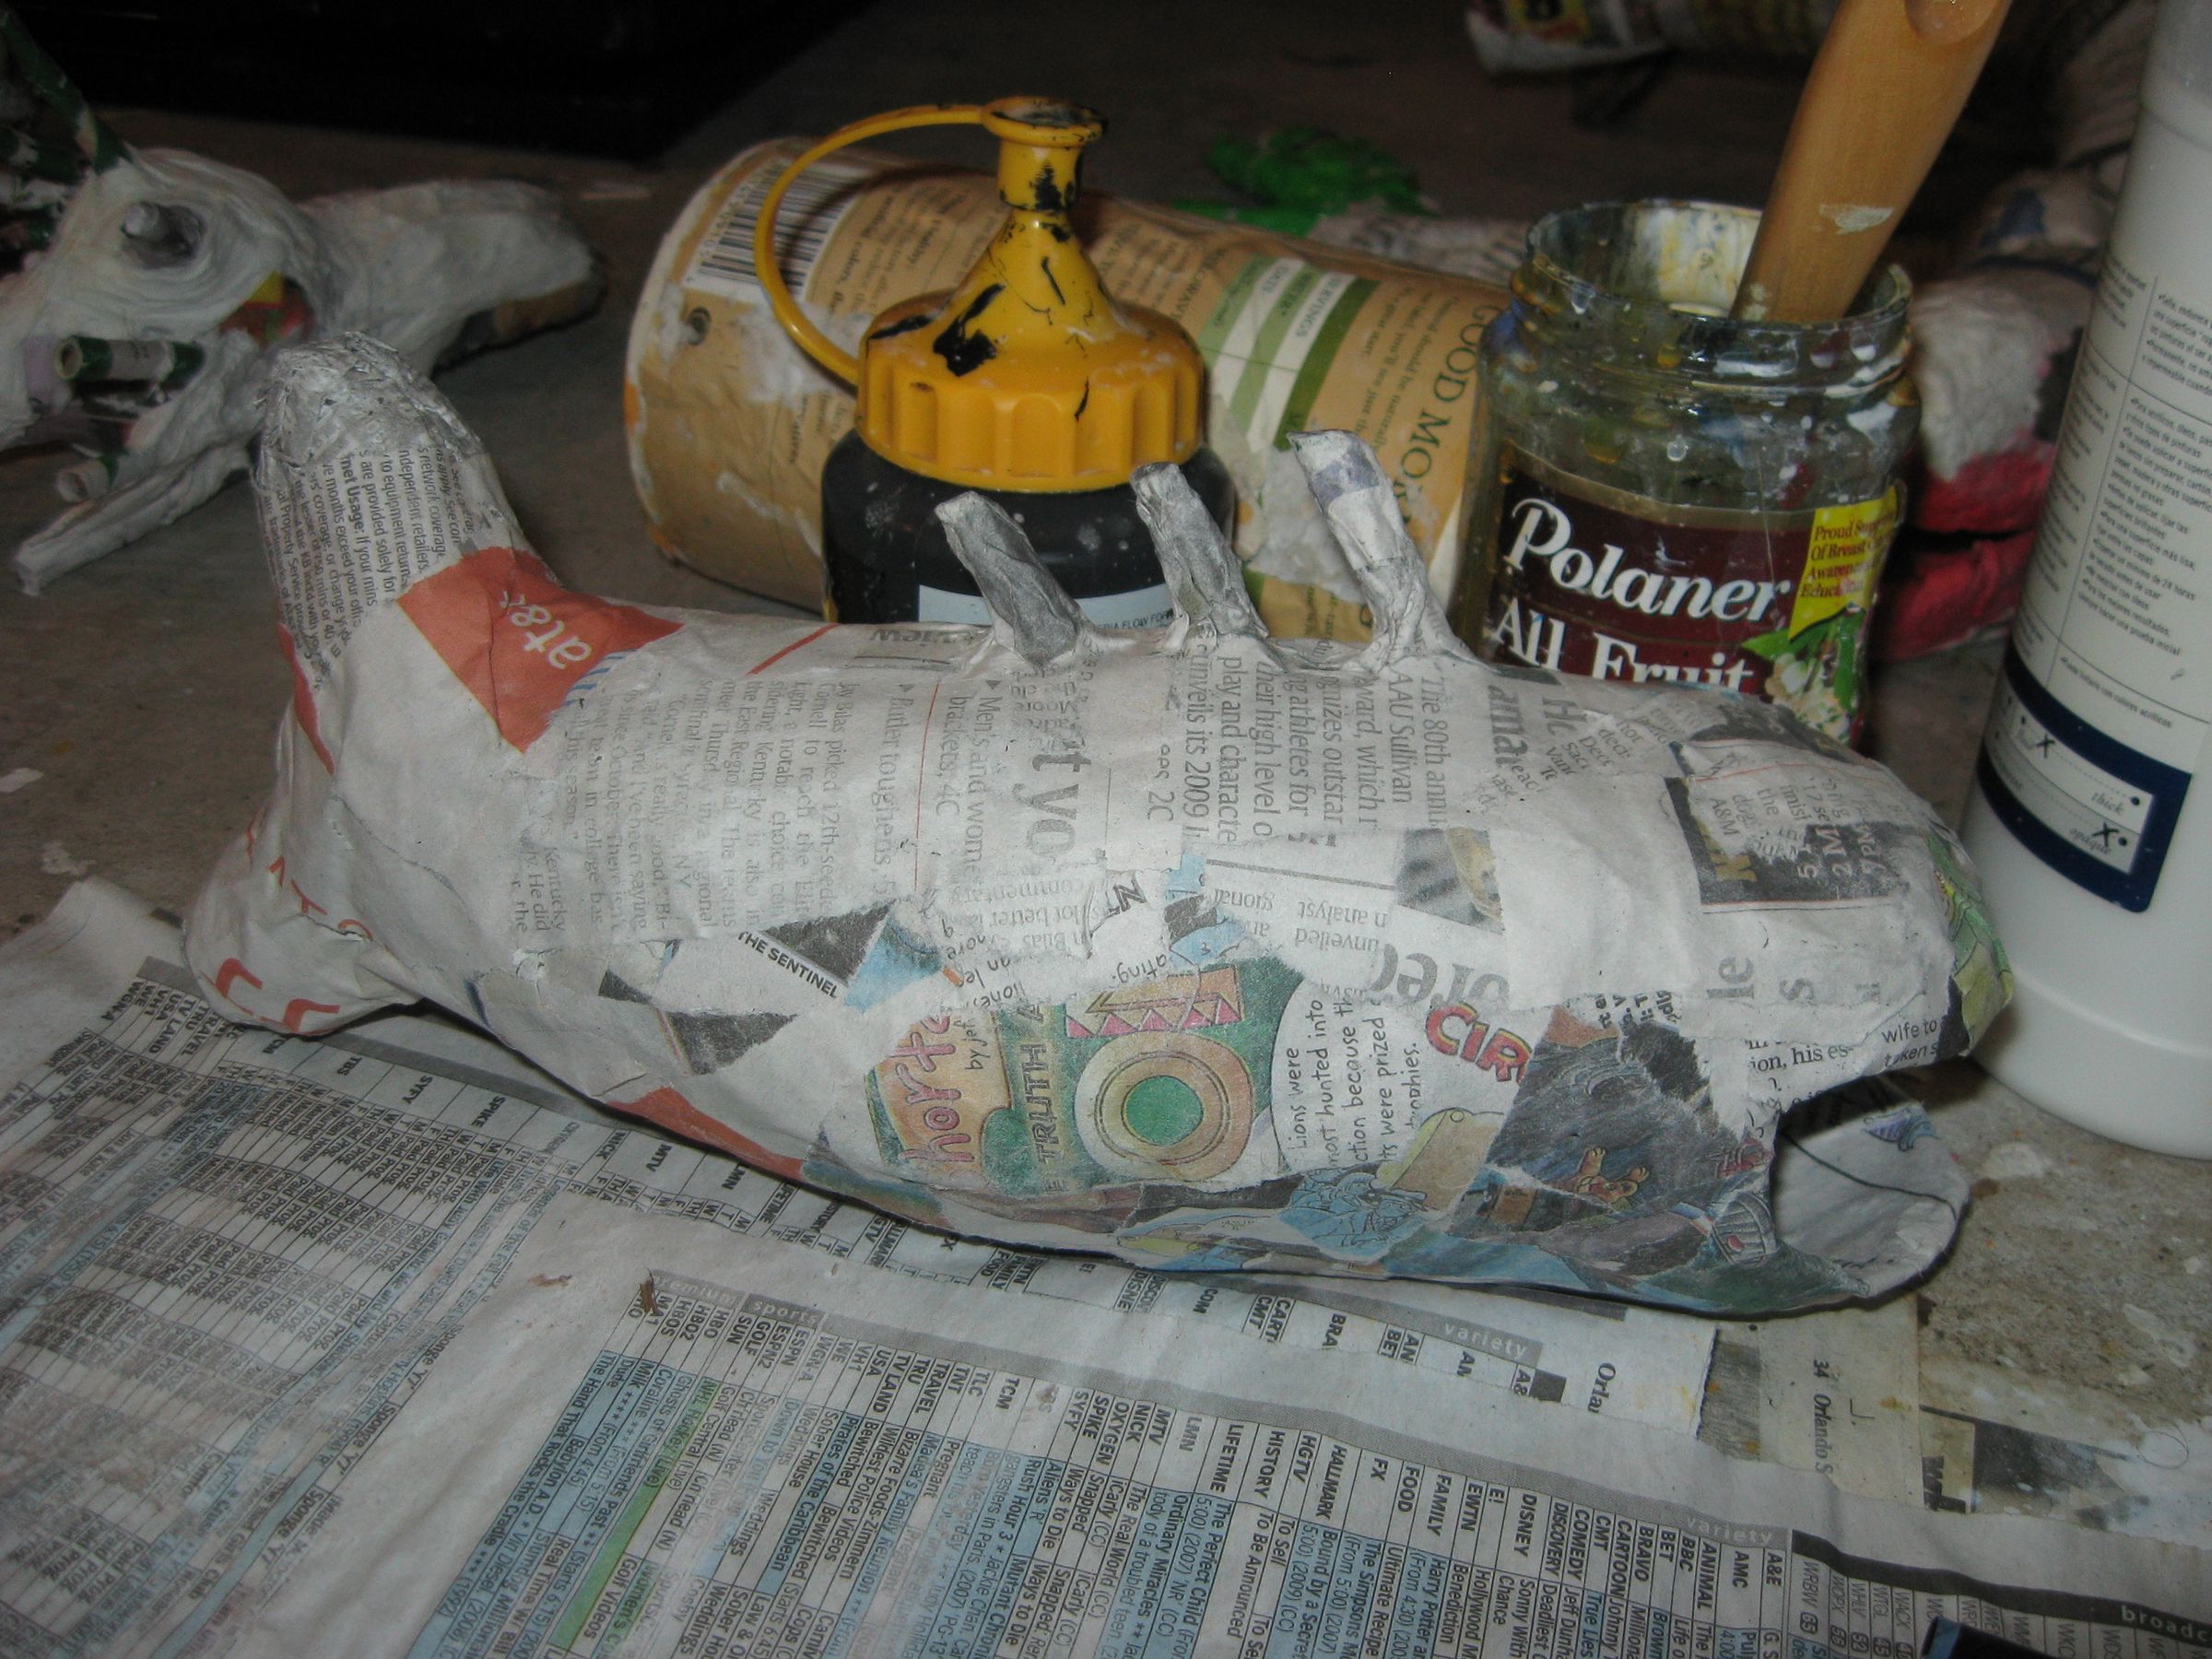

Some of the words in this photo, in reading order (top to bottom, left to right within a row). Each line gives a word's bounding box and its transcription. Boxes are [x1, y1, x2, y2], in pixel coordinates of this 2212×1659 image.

[1504, 498, 1794, 621] Polaner
[1494, 597, 1565, 671] All
[1592, 631, 1755, 693] Fruit
[1218, 655, 1248, 699] play
[1220, 700, 1248, 739] and
[1182, 760, 1212, 818] 2009
[1253, 762, 1281, 815] level
[1390, 724, 1418, 805] Sullivan
[1710, 797, 1741, 836] A&M
[738, 931, 769, 956] THE
[767, 947, 839, 999] SENTINEL
[1305, 999, 1326, 1039] into
[1881, 1022, 1920, 1044] wife
[1923, 1019, 1937, 1035] to
[1342, 1026, 1364, 1109] because
[1362, 1017, 1397, 1077] prized
[1791, 1045, 1823, 1066] his
[1287, 1047, 1304, 1098] were
[1306, 1048, 1335, 1117] hunted
[471, 1096, 506, 1128] SPIKE
[1020, 1043, 1064, 1165] TRUTH
[1379, 1088, 1395, 1135] were
[703, 1309, 730, 1338] HBO
[726, 1315, 753, 1345] SUN
[753, 1300, 820, 1325] sports
[744, 1321, 772, 1358] GOLF
[758, 1325, 792, 1370] ESPN2
[781, 1330, 810, 1367] ESPN
[865, 1348, 892, 1378] USA
[1443, 1321, 1529, 1358] variety
[873, 1373, 901, 1415] LAND
[907, 1358, 931, 1385] TRU
[915, 1362, 951, 1415] TRAVEL
[947, 1366, 971, 1395] TNT
[995, 1377, 1021, 1410] TCM
[1064, 1390, 1090, 1432] SYFY
[1082, 1395, 1110, 1441] SPIKE
[1096, 1401, 1130, 1467] OXYGEN
[1125, 1404, 1152, 1443] NICK
[1148, 1408, 1172, 1447] MTV
[1812, 1393, 1833, 1462] Orlando
[828, 1415, 860, 1460] Pirates
[837, 1420, 880, 1488] Bewitched
[1209, 1423, 1244, 1494] LIFETIME
[1292, 1434, 1318, 1484] HGTV
[1254, 1430, 1286, 1499] HISTORY
[1315, 1444, 1347, 1520] HALLMARK
[1370, 1457, 1389, 1482] FX
[1397, 1465, 1420, 1512] FOOD
[847, 1475, 876, 1516] Police
[1071, 1474, 1105, 1535] Snapped
[1427, 1474, 1453, 1537] FAMILY
[1460, 1482, 1484, 1532] EWTN
[771, 1500, 816, 1572] Caribbean
[824, 1519, 852, 1562] Videos
[1155, 1494, 1189, 1559] Ordinary
[1513, 1493, 1537, 1558] DISNEY
[1545, 1501, 1569, 1578] DISCOVERY
[1567, 1508, 1590, 1582] COMEDY
[1593, 1514, 1611, 1551] CMT
[1659, 1529, 1676, 1562] BET
[1105, 1545, 1127, 1589] World
[1377, 1547, 1404, 1607] Ultimate
[1610, 1520, 1632, 1598] CARTOON
[1633, 1525, 1655, 1583] BRAVO
[1679, 1536, 1696, 1572] BBC
[1697, 1541, 1717, 1610] ANIMAL
[1732, 1550, 1749, 1589] AMC
[1766, 1552, 1783, 1587] A&E
[1138, 1559, 1170, 1618] Miracles
[1227, 1556, 1263, 1640] Announced
[1347, 1570, 1375, 1640] Simpsons
[1439, 1563, 1469, 1645] Benediction
[1464, 1569, 1491, 1641] Hollywood
[1493, 1574, 1514, 1625] Chance
